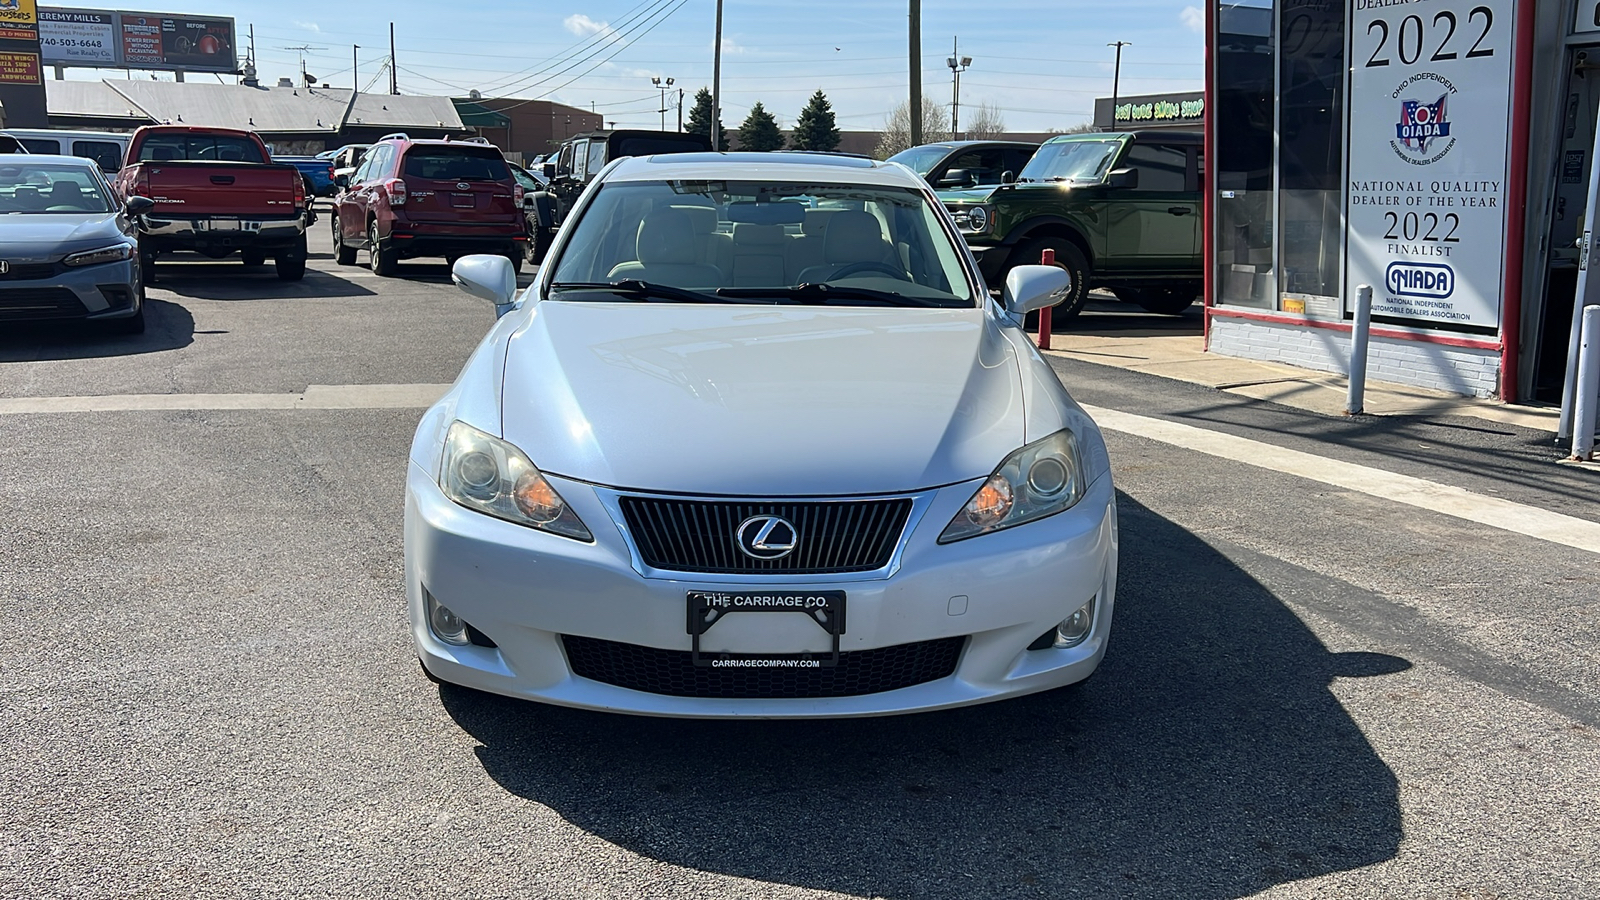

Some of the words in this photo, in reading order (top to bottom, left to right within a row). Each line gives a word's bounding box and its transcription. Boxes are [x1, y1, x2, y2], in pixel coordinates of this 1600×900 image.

[1357, 0, 1409, 10] DEAL
[73, 14, 101, 22] MILLS
[40, 38, 102, 48] 740-503-6648
[1365, 6, 1494, 68] 2022
[81, 49, 100, 58] Realty
[1392, 80, 1409, 99] OHIO
[1409, 72, 1458, 95] INDEPENDENT
[1402, 124, 1441, 137] OIADA
[1389, 140, 1411, 164] AUTOMOBILE
[1431, 137, 1457, 163] ASSOCIATION
[1351, 181, 1424, 192] NATIONAL
[1430, 181, 1500, 194] QUALITY
[1352, 195, 1400, 206] DEALER
[1406, 196, 1422, 206] OF
[1428, 196, 1454, 207] THE
[1461, 197, 1498, 208] YEAR
[1383, 211, 1460, 242] 2022
[1388, 243, 1453, 257] FINALIST
[1391, 269, 1448, 292] NIADA
[1386, 297, 1413, 306] NATIONAL
[1414, 301, 1454, 310] INDEPENDENT
[1371, 304, 1404, 314] AUTOMOBILE
[1405, 307, 1430, 317] DEALERS
[1430, 311, 1471, 320] ASSOCIATION
[705, 596, 731, 607] THE
[734, 596, 803, 607] CARRIAGE
[806, 596, 829, 607] CO.
[712, 660, 820, 668] CARRIAGECOMPANY.COM
